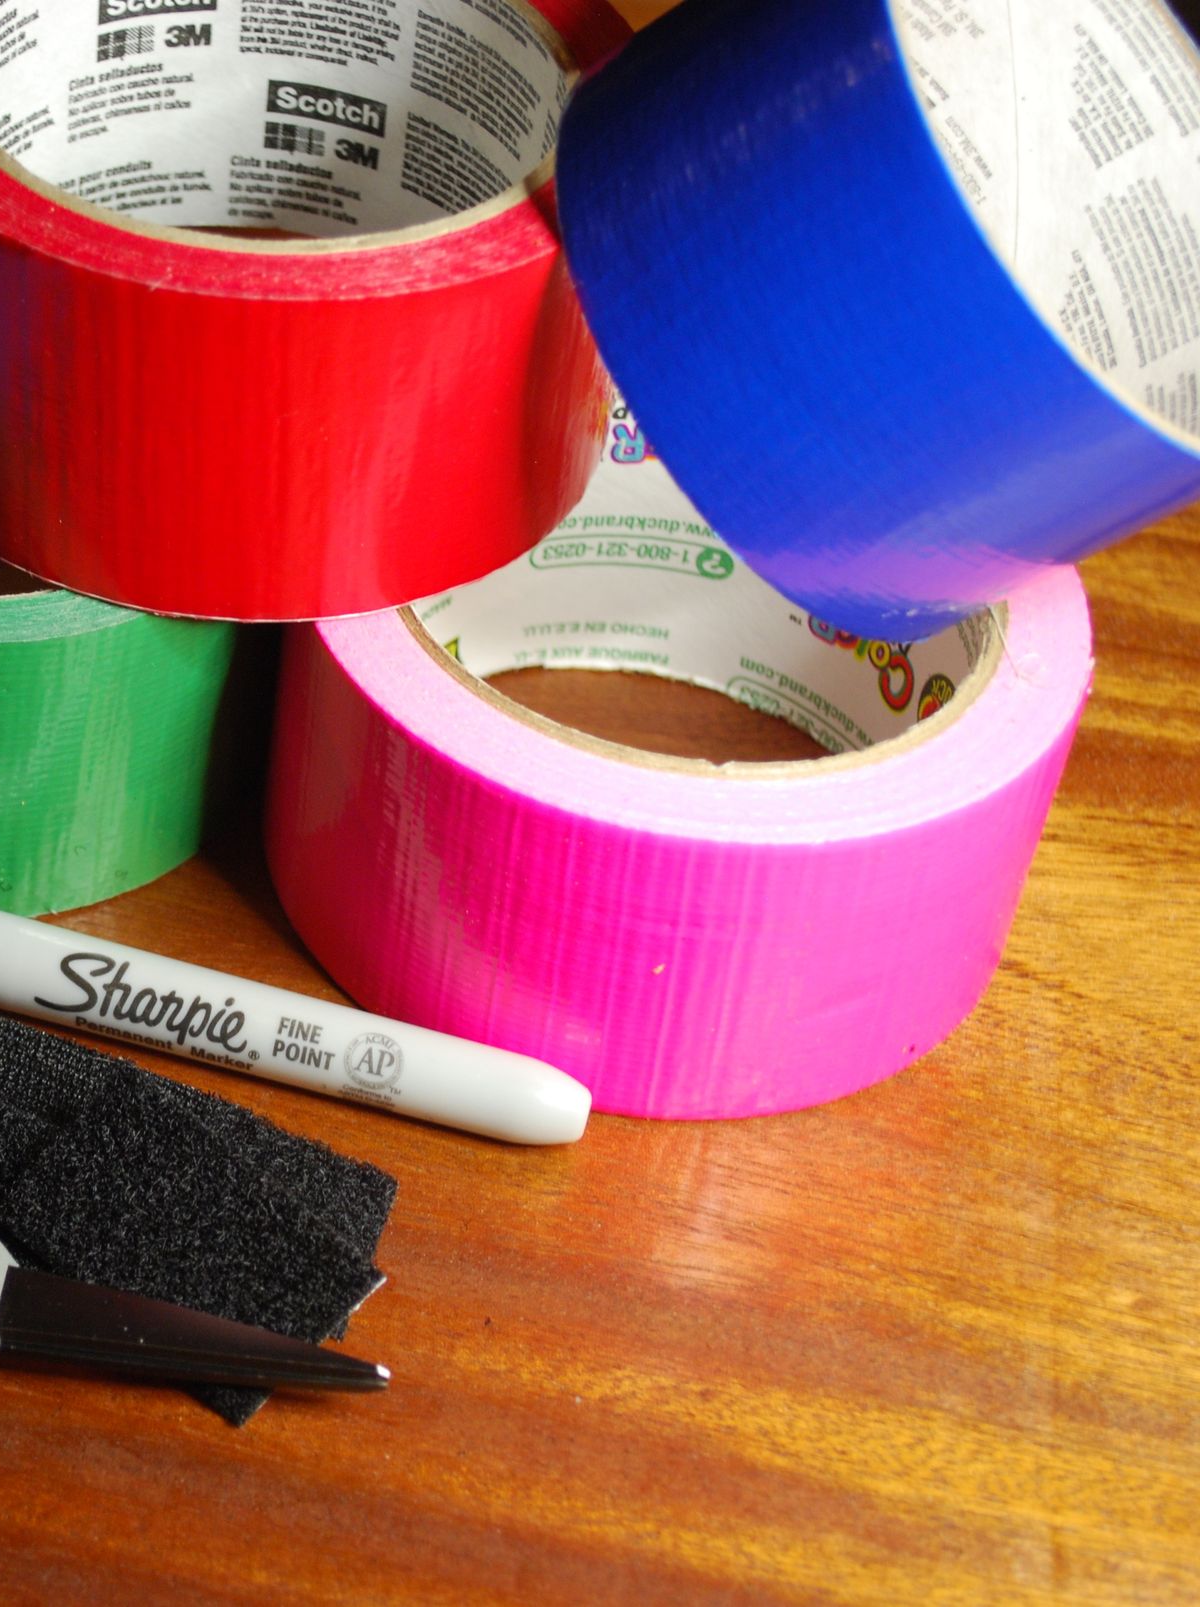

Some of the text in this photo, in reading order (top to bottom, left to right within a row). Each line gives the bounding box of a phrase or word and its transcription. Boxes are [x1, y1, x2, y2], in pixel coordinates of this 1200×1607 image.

[165, 24, 211, 47] 3M
[275, 86, 380, 129] Scotch
[334, 138, 380, 170] 3M
[543, 542, 691, 565] 1-800-321-0253
[584, 621, 607, 634] EN
[612, 623, 670, 641] HECHO
[34, 952, 247, 1053] Sharpie
[75, 1016, 255, 1070] Permanent Marker
[277, 1016, 324, 1045] FINE
[272, 1039, 336, 1071] POINT
[353, 1045, 395, 1077] AP
